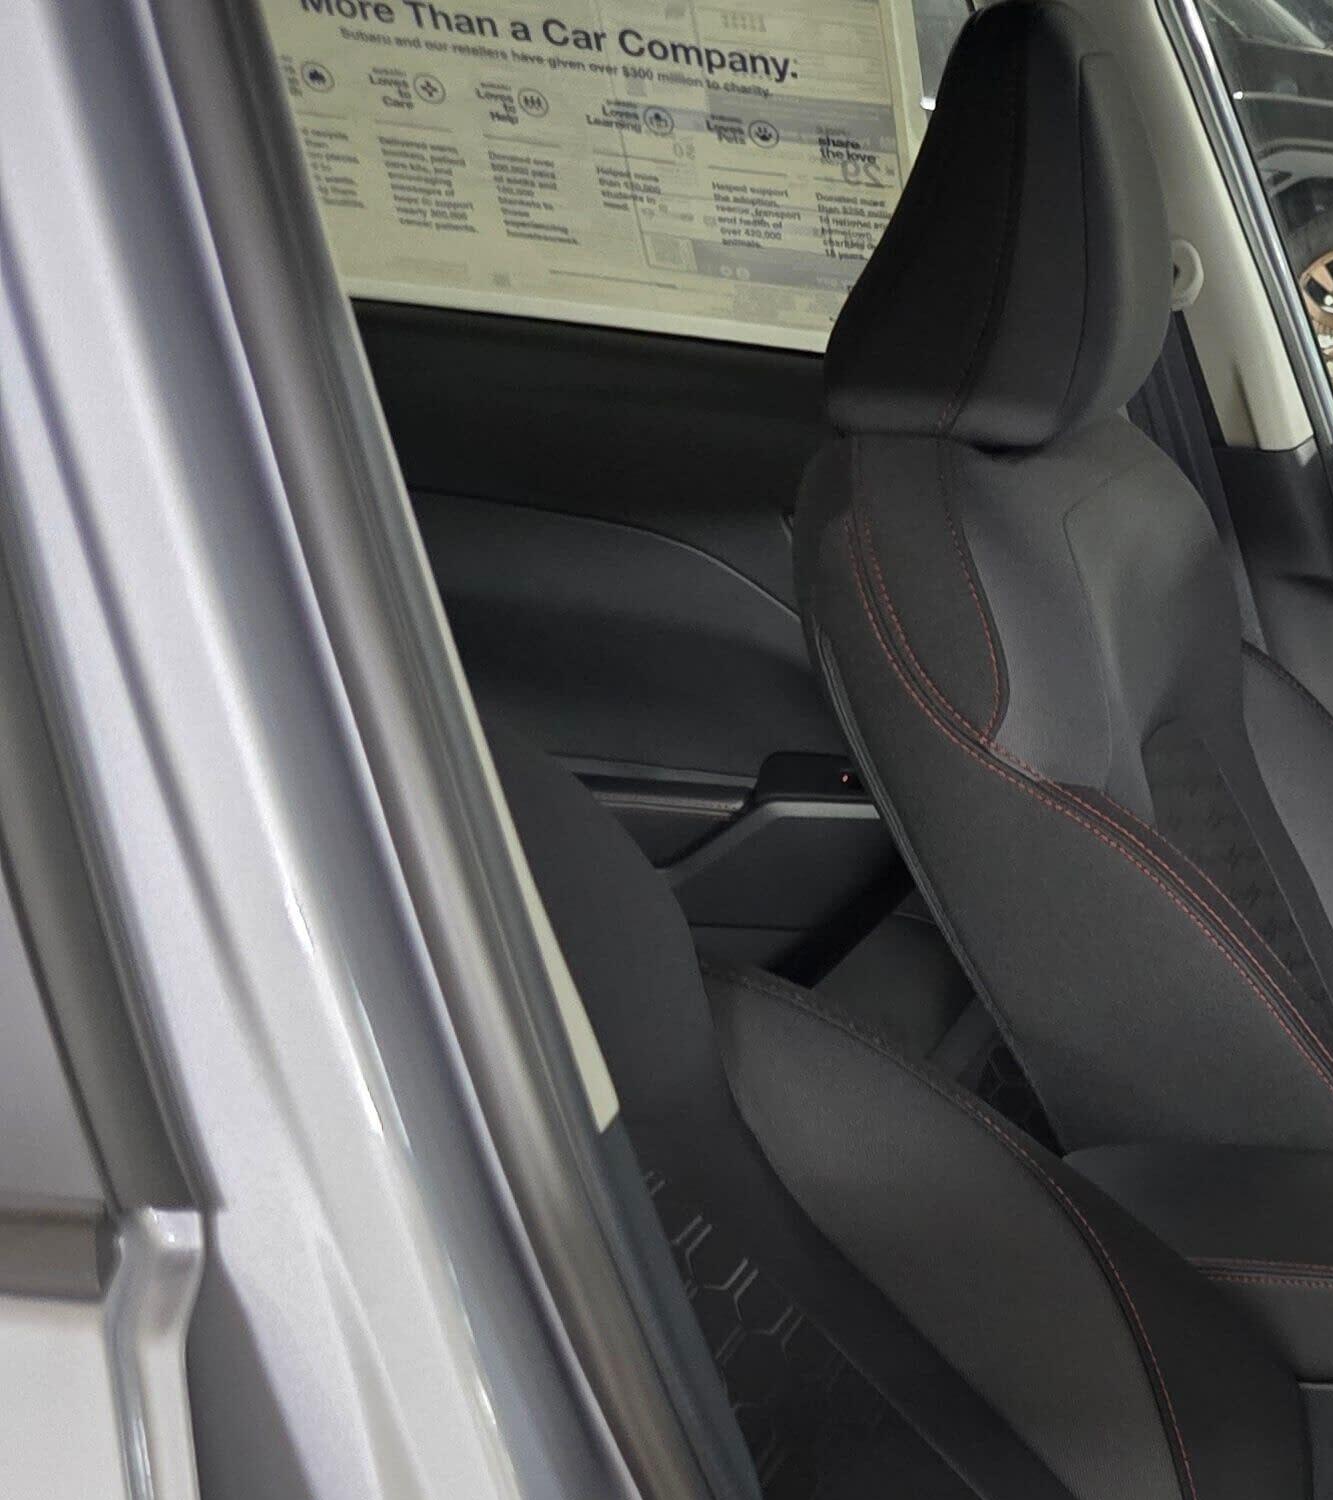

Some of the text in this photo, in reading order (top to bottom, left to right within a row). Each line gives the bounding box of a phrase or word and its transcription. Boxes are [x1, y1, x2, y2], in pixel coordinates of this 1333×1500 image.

[404, 1, 499, 38] Than
[510, 20, 532, 42] a
[542, 18, 607, 53] Car
[617, 28, 799, 83] Company.
[338, 25, 393, 46] Subaru
[394, 35, 422, 49] and
[425, 40, 447, 51] our
[451, 42, 508, 60] retailers
[510, 50, 546, 66] have
[547, 55, 586, 72] given
[589, 63, 617, 76] over
[622, 65, 654, 81] $300
[657, 70, 702, 87] million
[705, 78, 720, 91] to
[368, 73, 409, 89] Loves
[382, 95, 414, 110] Care
[489, 111, 519, 125] Help
